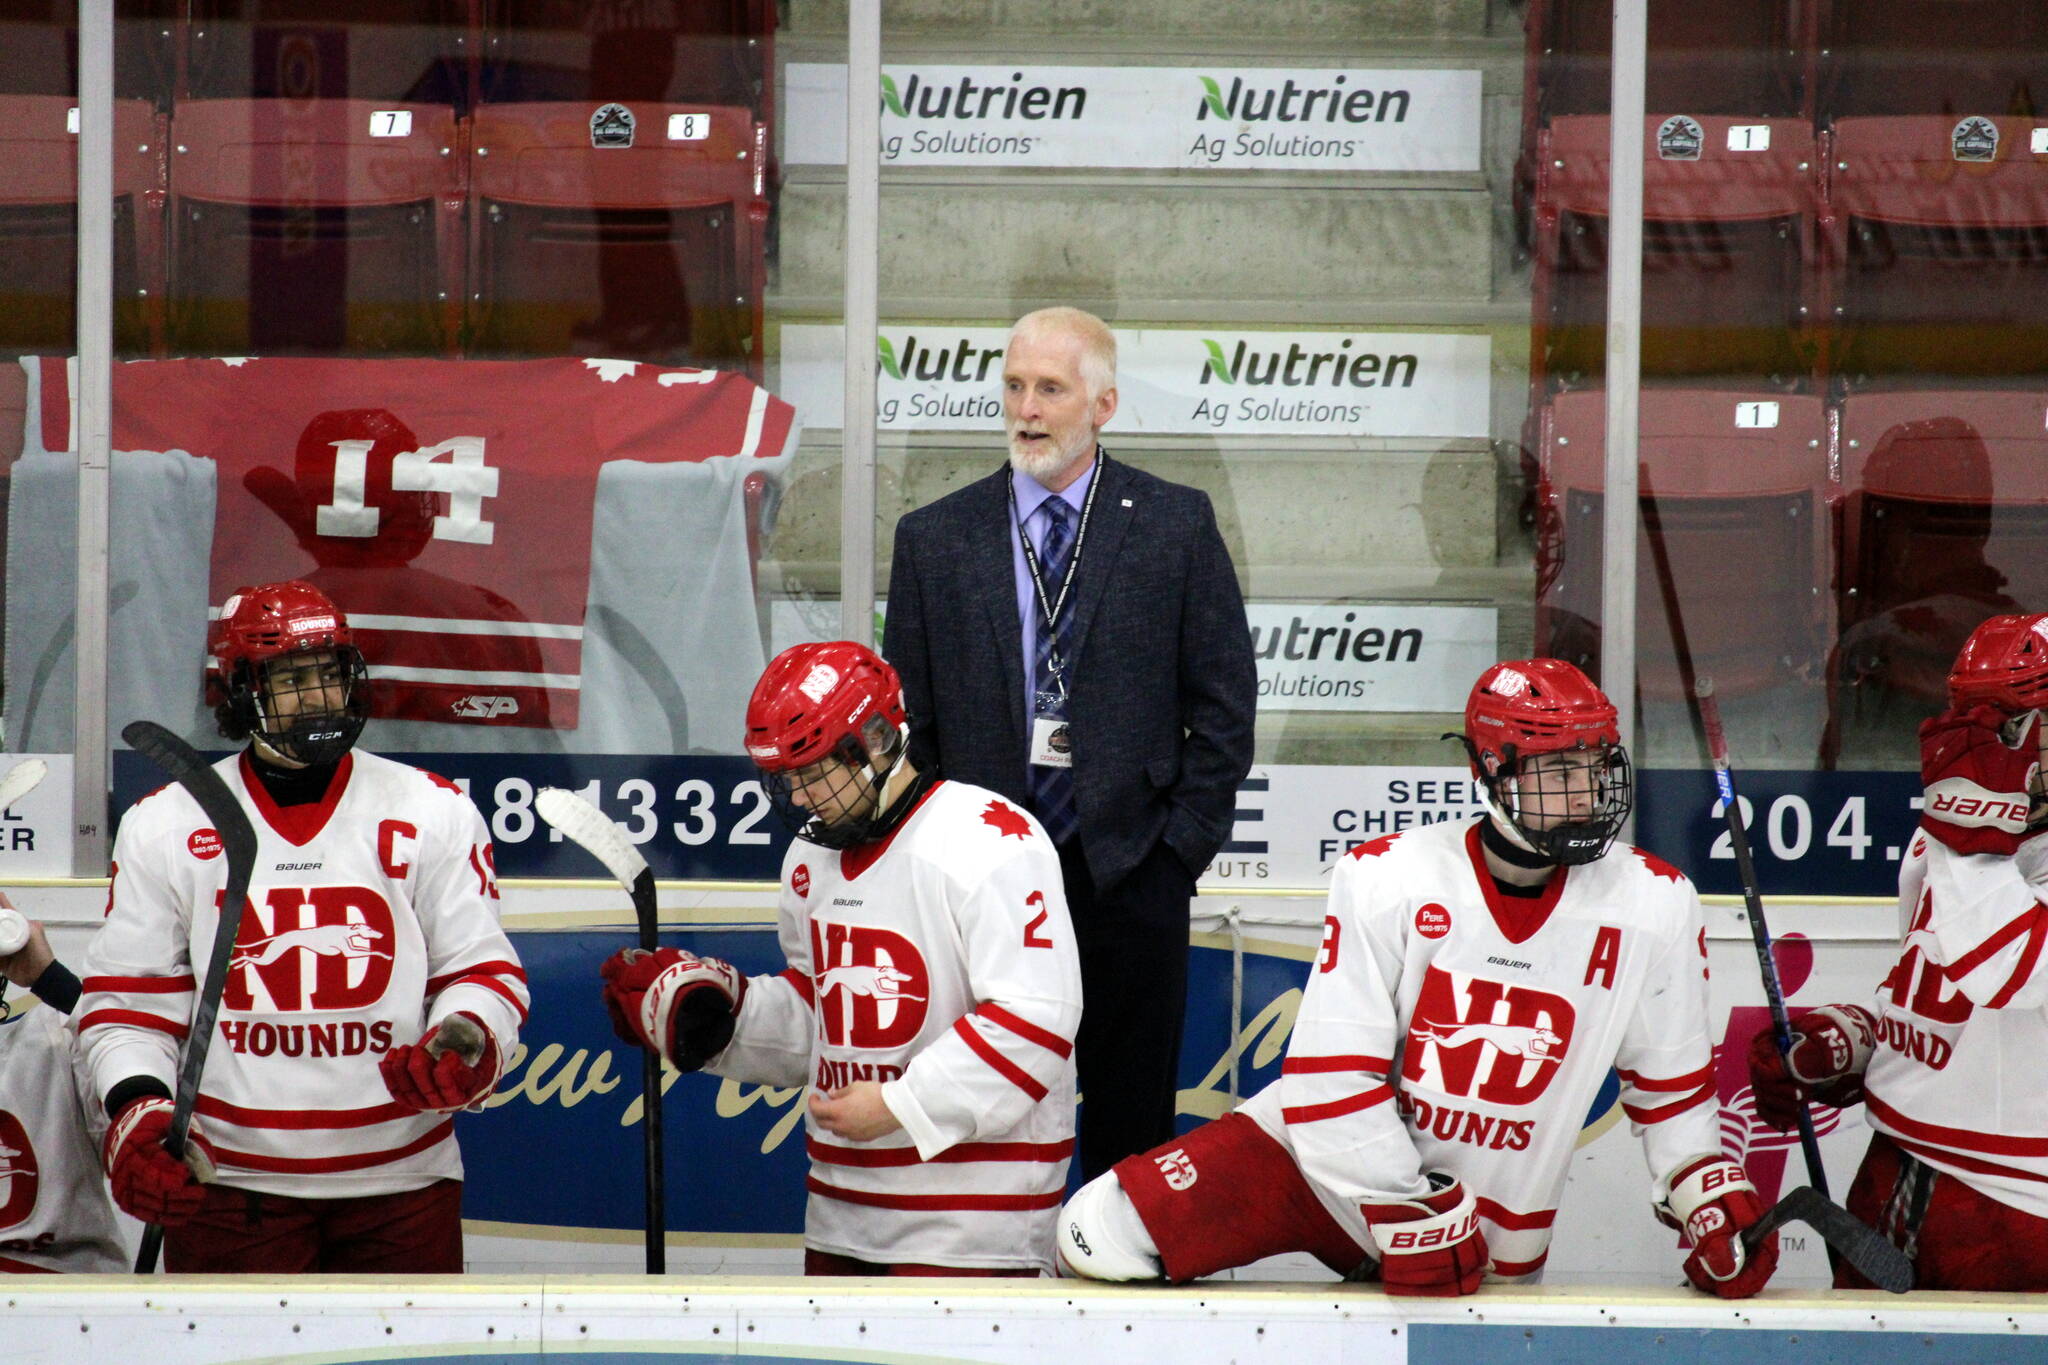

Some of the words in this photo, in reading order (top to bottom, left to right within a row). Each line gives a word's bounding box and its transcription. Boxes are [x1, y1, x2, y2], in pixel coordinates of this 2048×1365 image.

[880, 72, 1087, 120] Nutrien
[1196, 75, 1410, 123] Nutrien
[387, 114, 396, 134] 7
[684, 116, 693, 137] 8
[1745, 128, 1751, 149] 1
[879, 136, 903, 159] g
[1189, 134, 1226, 162] Ag
[878, 335, 1004, 382] Nutr
[1200, 338, 1418, 388] Nutrien
[877, 399, 900, 423] g
[906, 393, 1005, 417] Solutio
[1192, 398, 1230, 427] Ag
[1752, 404, 1761, 425] 1
[316, 435, 499, 545] 14
[291, 618, 335, 633] HOUNDS
[1250, 612, 1424, 663] utrien
[1257, 672, 1365, 698] olutions
[848, 694, 873, 724] CCM
[1931, 793, 2030, 823] AUER
[1709, 793, 1926, 861] 204.
[377, 819, 418, 880] C
[275, 862, 323, 871] BAUER
[833, 898, 863, 907] BAUER
[1422, 911, 1444, 922] PERE
[1024, 890, 1053, 949] 2
[214, 886, 396, 1012] ND
[1487, 956, 1532, 970] BAUER
[1583, 926, 1622, 991] A
[219, 1021, 393, 1058] HOUNDS
[1402, 964, 1576, 1106] ND
[1153, 1148, 1198, 1191] ND
[1390, 1209, 1481, 1249] BAUE
[1781, 1237, 1806, 1251] TM
